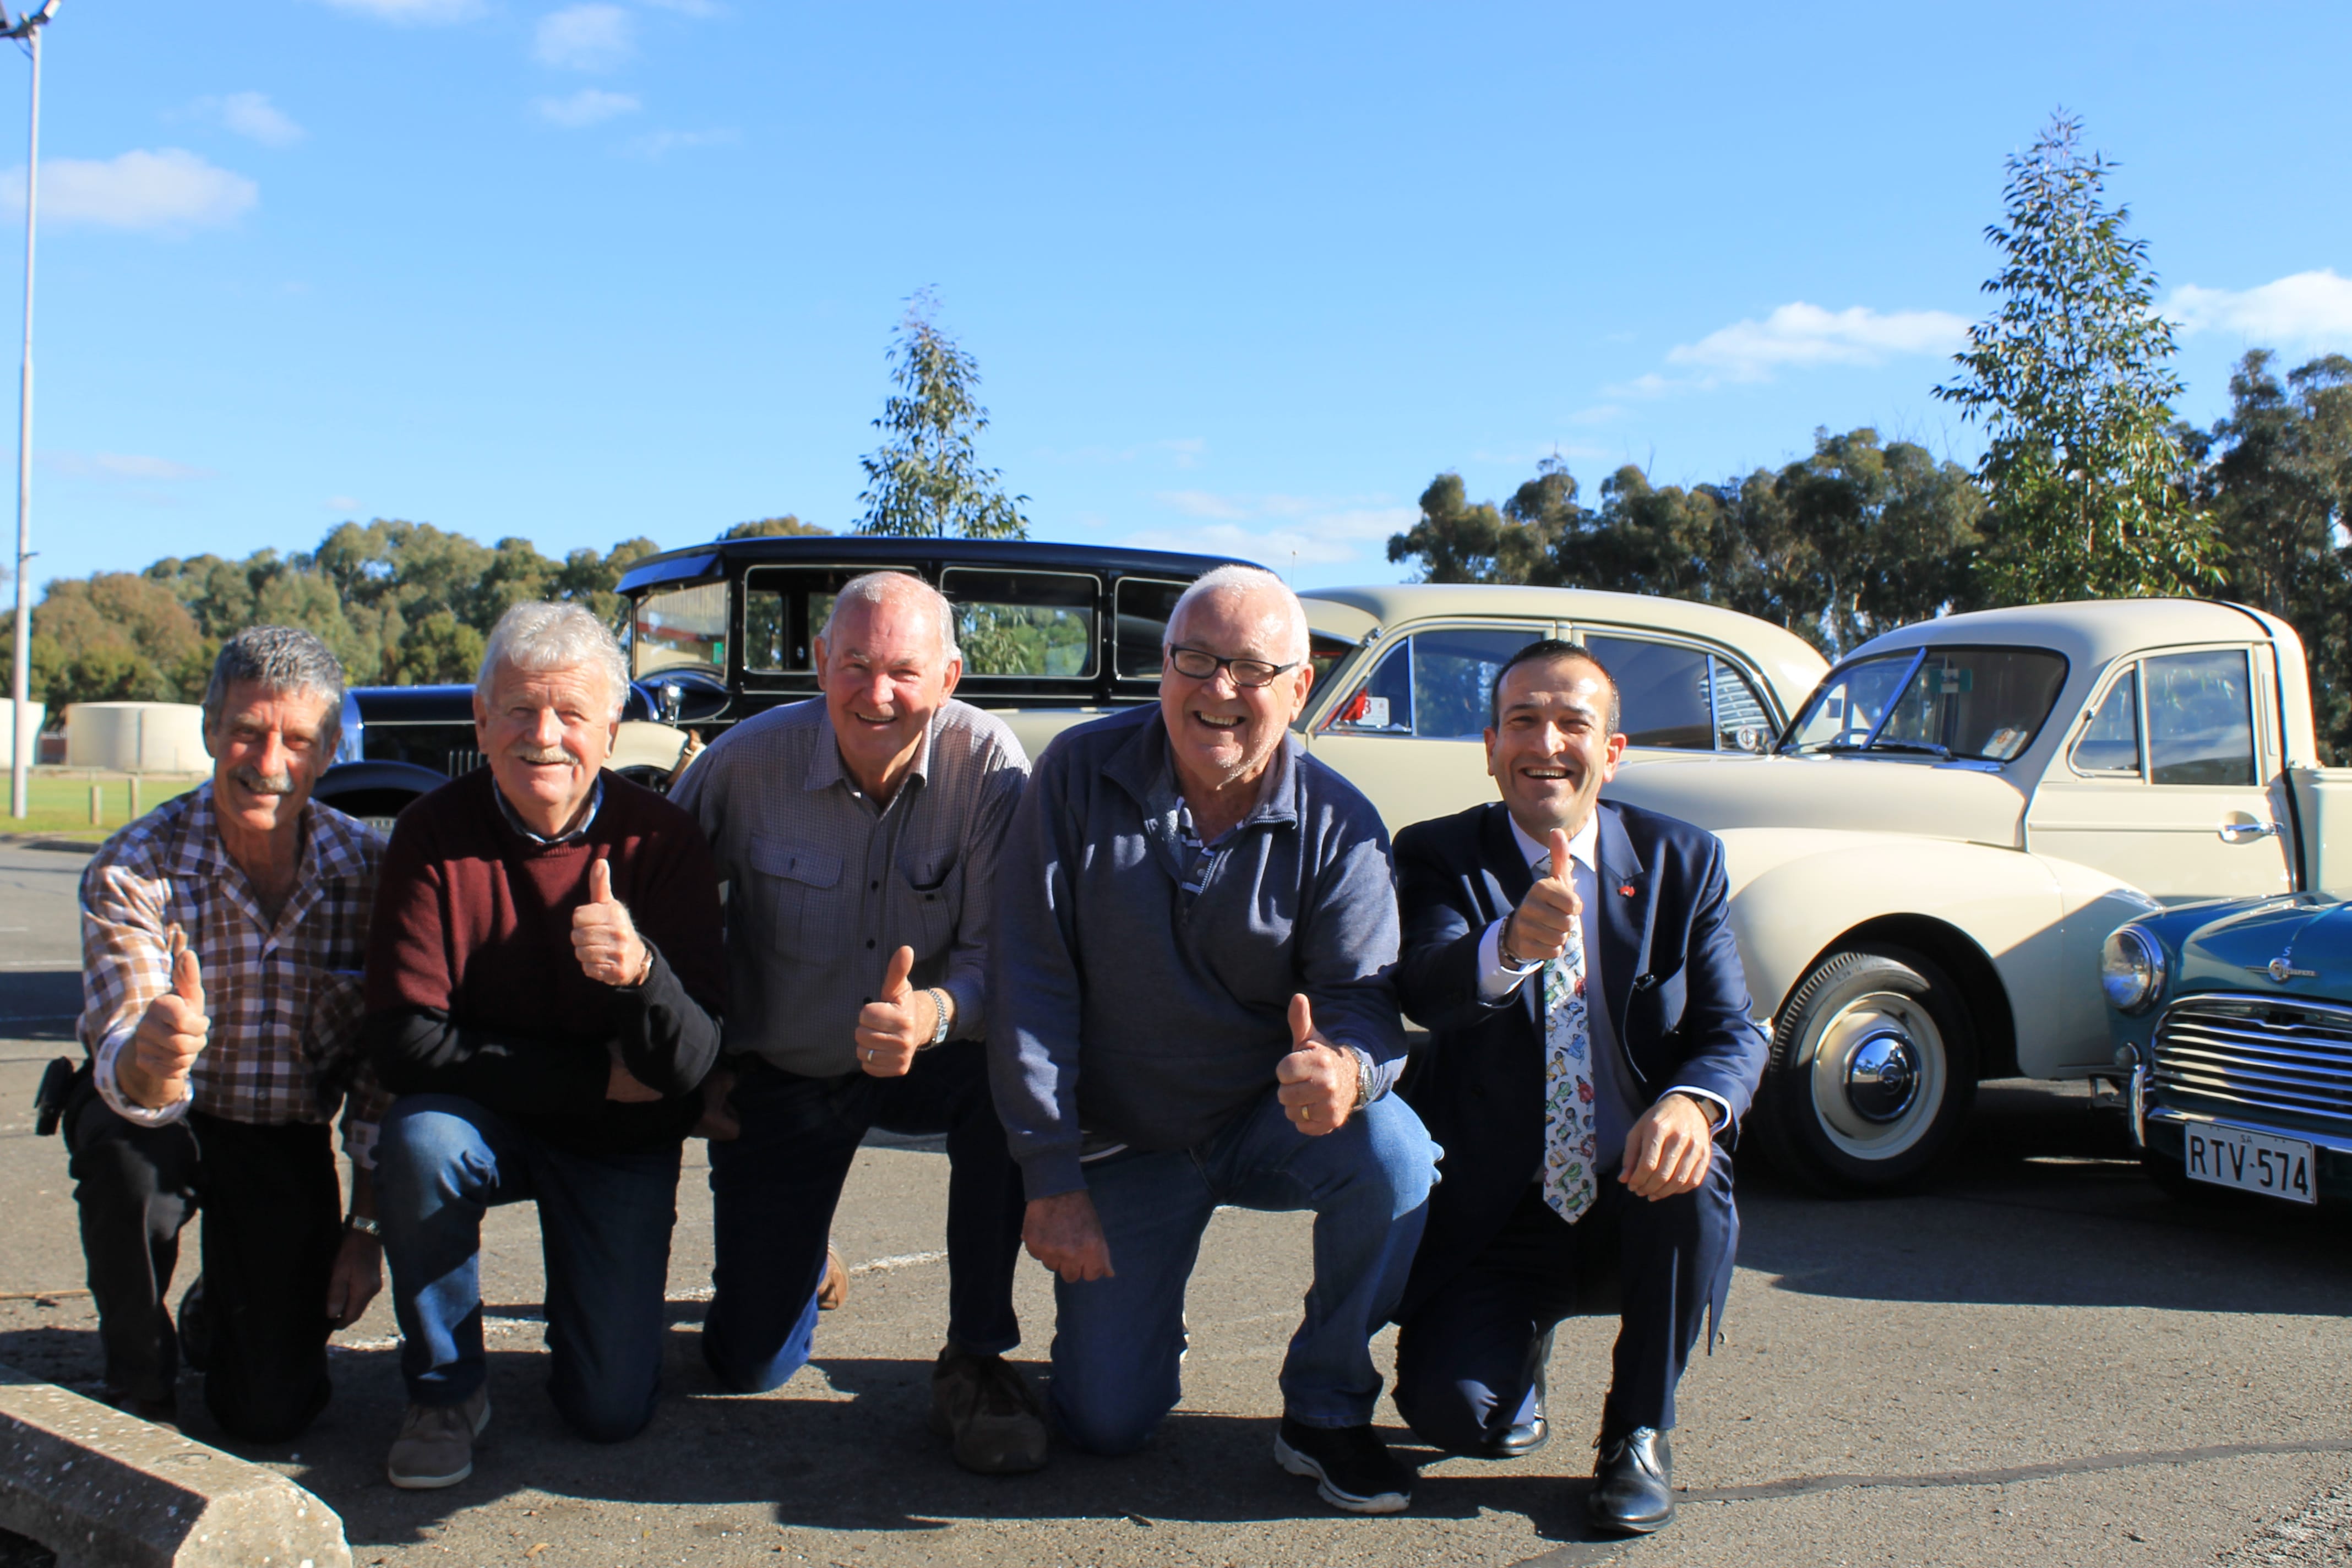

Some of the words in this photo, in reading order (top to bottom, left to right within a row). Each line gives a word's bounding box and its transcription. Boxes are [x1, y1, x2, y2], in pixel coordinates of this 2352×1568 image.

[2283, 946, 2292, 956] S
[2240, 1134, 2252, 1144] SA
[2190, 1135, 2308, 1195] RTV-574
